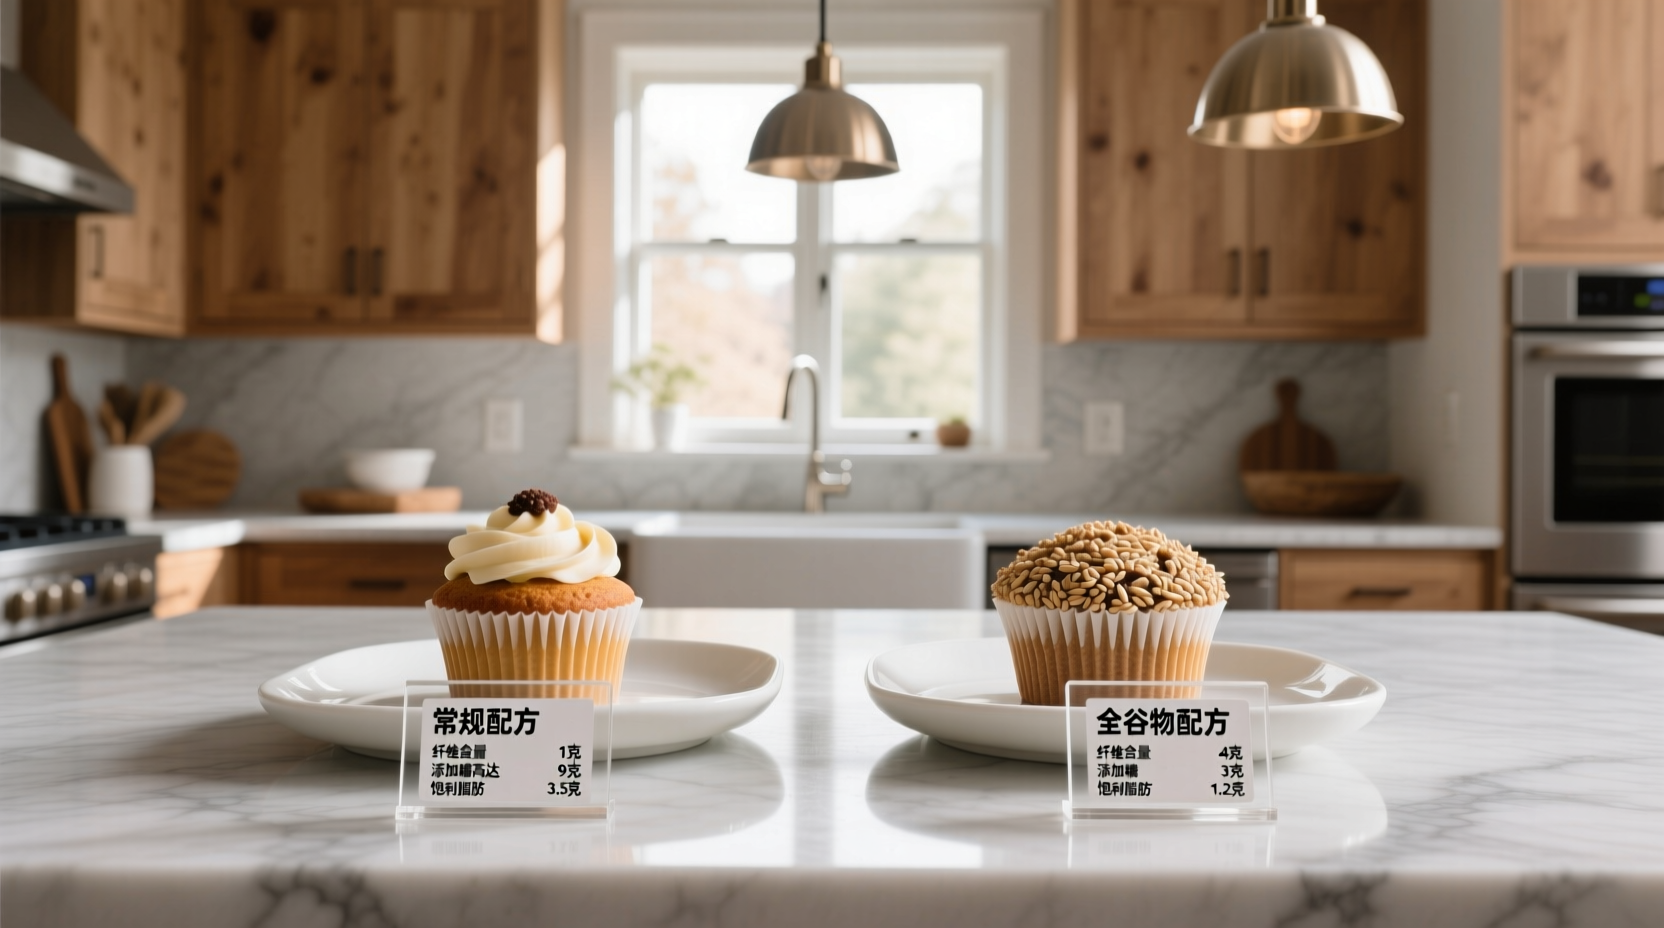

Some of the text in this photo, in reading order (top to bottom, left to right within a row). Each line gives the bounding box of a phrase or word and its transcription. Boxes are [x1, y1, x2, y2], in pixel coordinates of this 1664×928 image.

[433, 707, 540, 735] 常规配方
[1096, 707, 1230, 736] 全谷物配方
[559, 743, 582, 760] 1克
[1218, 744, 1243, 760] 4克
[557, 762, 582, 779] 9克
[1221, 763, 1244, 779] 3克
[547, 781, 582, 797] 3.5克
[1210, 782, 1245, 797] 1.2克
